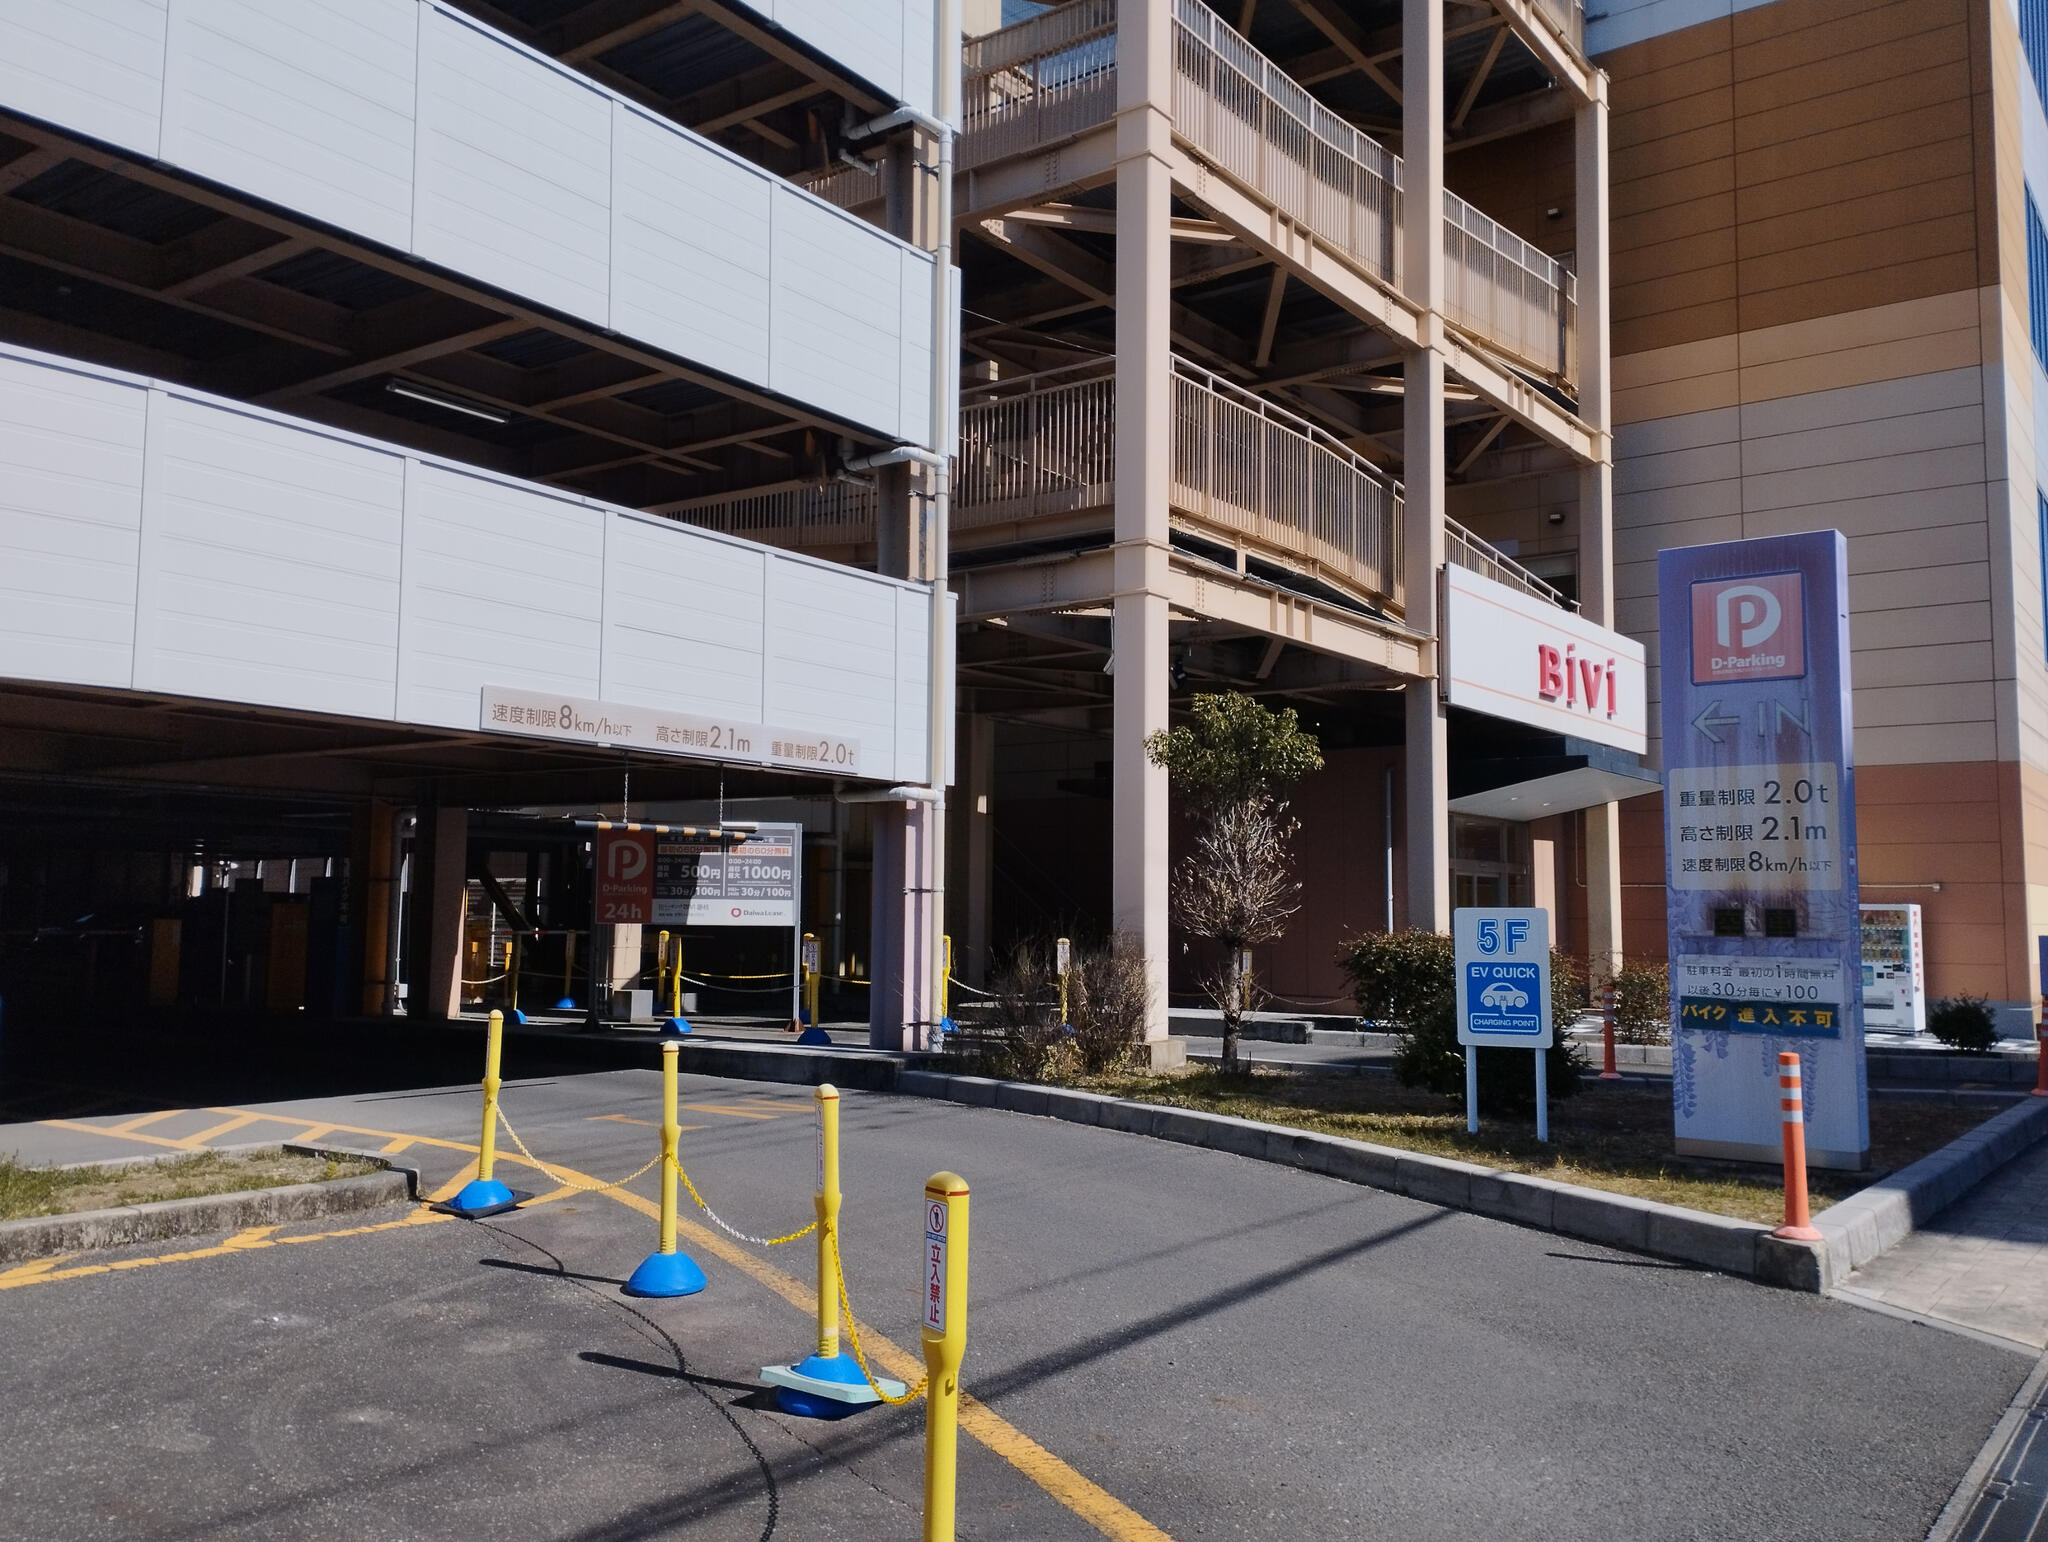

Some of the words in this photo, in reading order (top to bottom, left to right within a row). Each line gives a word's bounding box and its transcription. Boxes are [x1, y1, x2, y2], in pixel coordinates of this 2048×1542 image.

[1711, 653, 1786, 670] D-Parking
[1757, 699, 1811, 737] IN
[491, 703, 632, 737] 速度制限8km/h以下
[655, 723, 751, 753] 高さ制限2.1m
[770, 740, 855, 766] 重量制限2.0t
[1679, 789, 1755, 807] 重量制限
[1763, 779, 1828, 804] 2.0t
[1680, 825, 1753, 842] 高さ制限
[1761, 816, 1827, 841] 2.1m
[681, 865, 721, 880] 500円
[1682, 851, 1832, 874] 速度制限8km/h以下
[742, 866, 792, 880] 1000円
[602, 883, 648, 895] D-Parking
[604, 903, 643, 919] 24h
[1477, 919, 1530, 955] 5F
[1471, 966, 1489, 978] EV
[1492, 967, 1536, 979] QUICK
[1686, 965, 1733, 978] 駐車料金
[1738, 964, 1835, 981] 最初の1時間無料
[1473, 1018, 1512, 1027] CHARGING
[1512, 1019, 1536, 1028] POINT
[1681, 1004, 1727, 1021] バイク
[1737, 1008, 1834, 1029] 進入不可
[929, 1243, 942, 1325] 立入禁止
